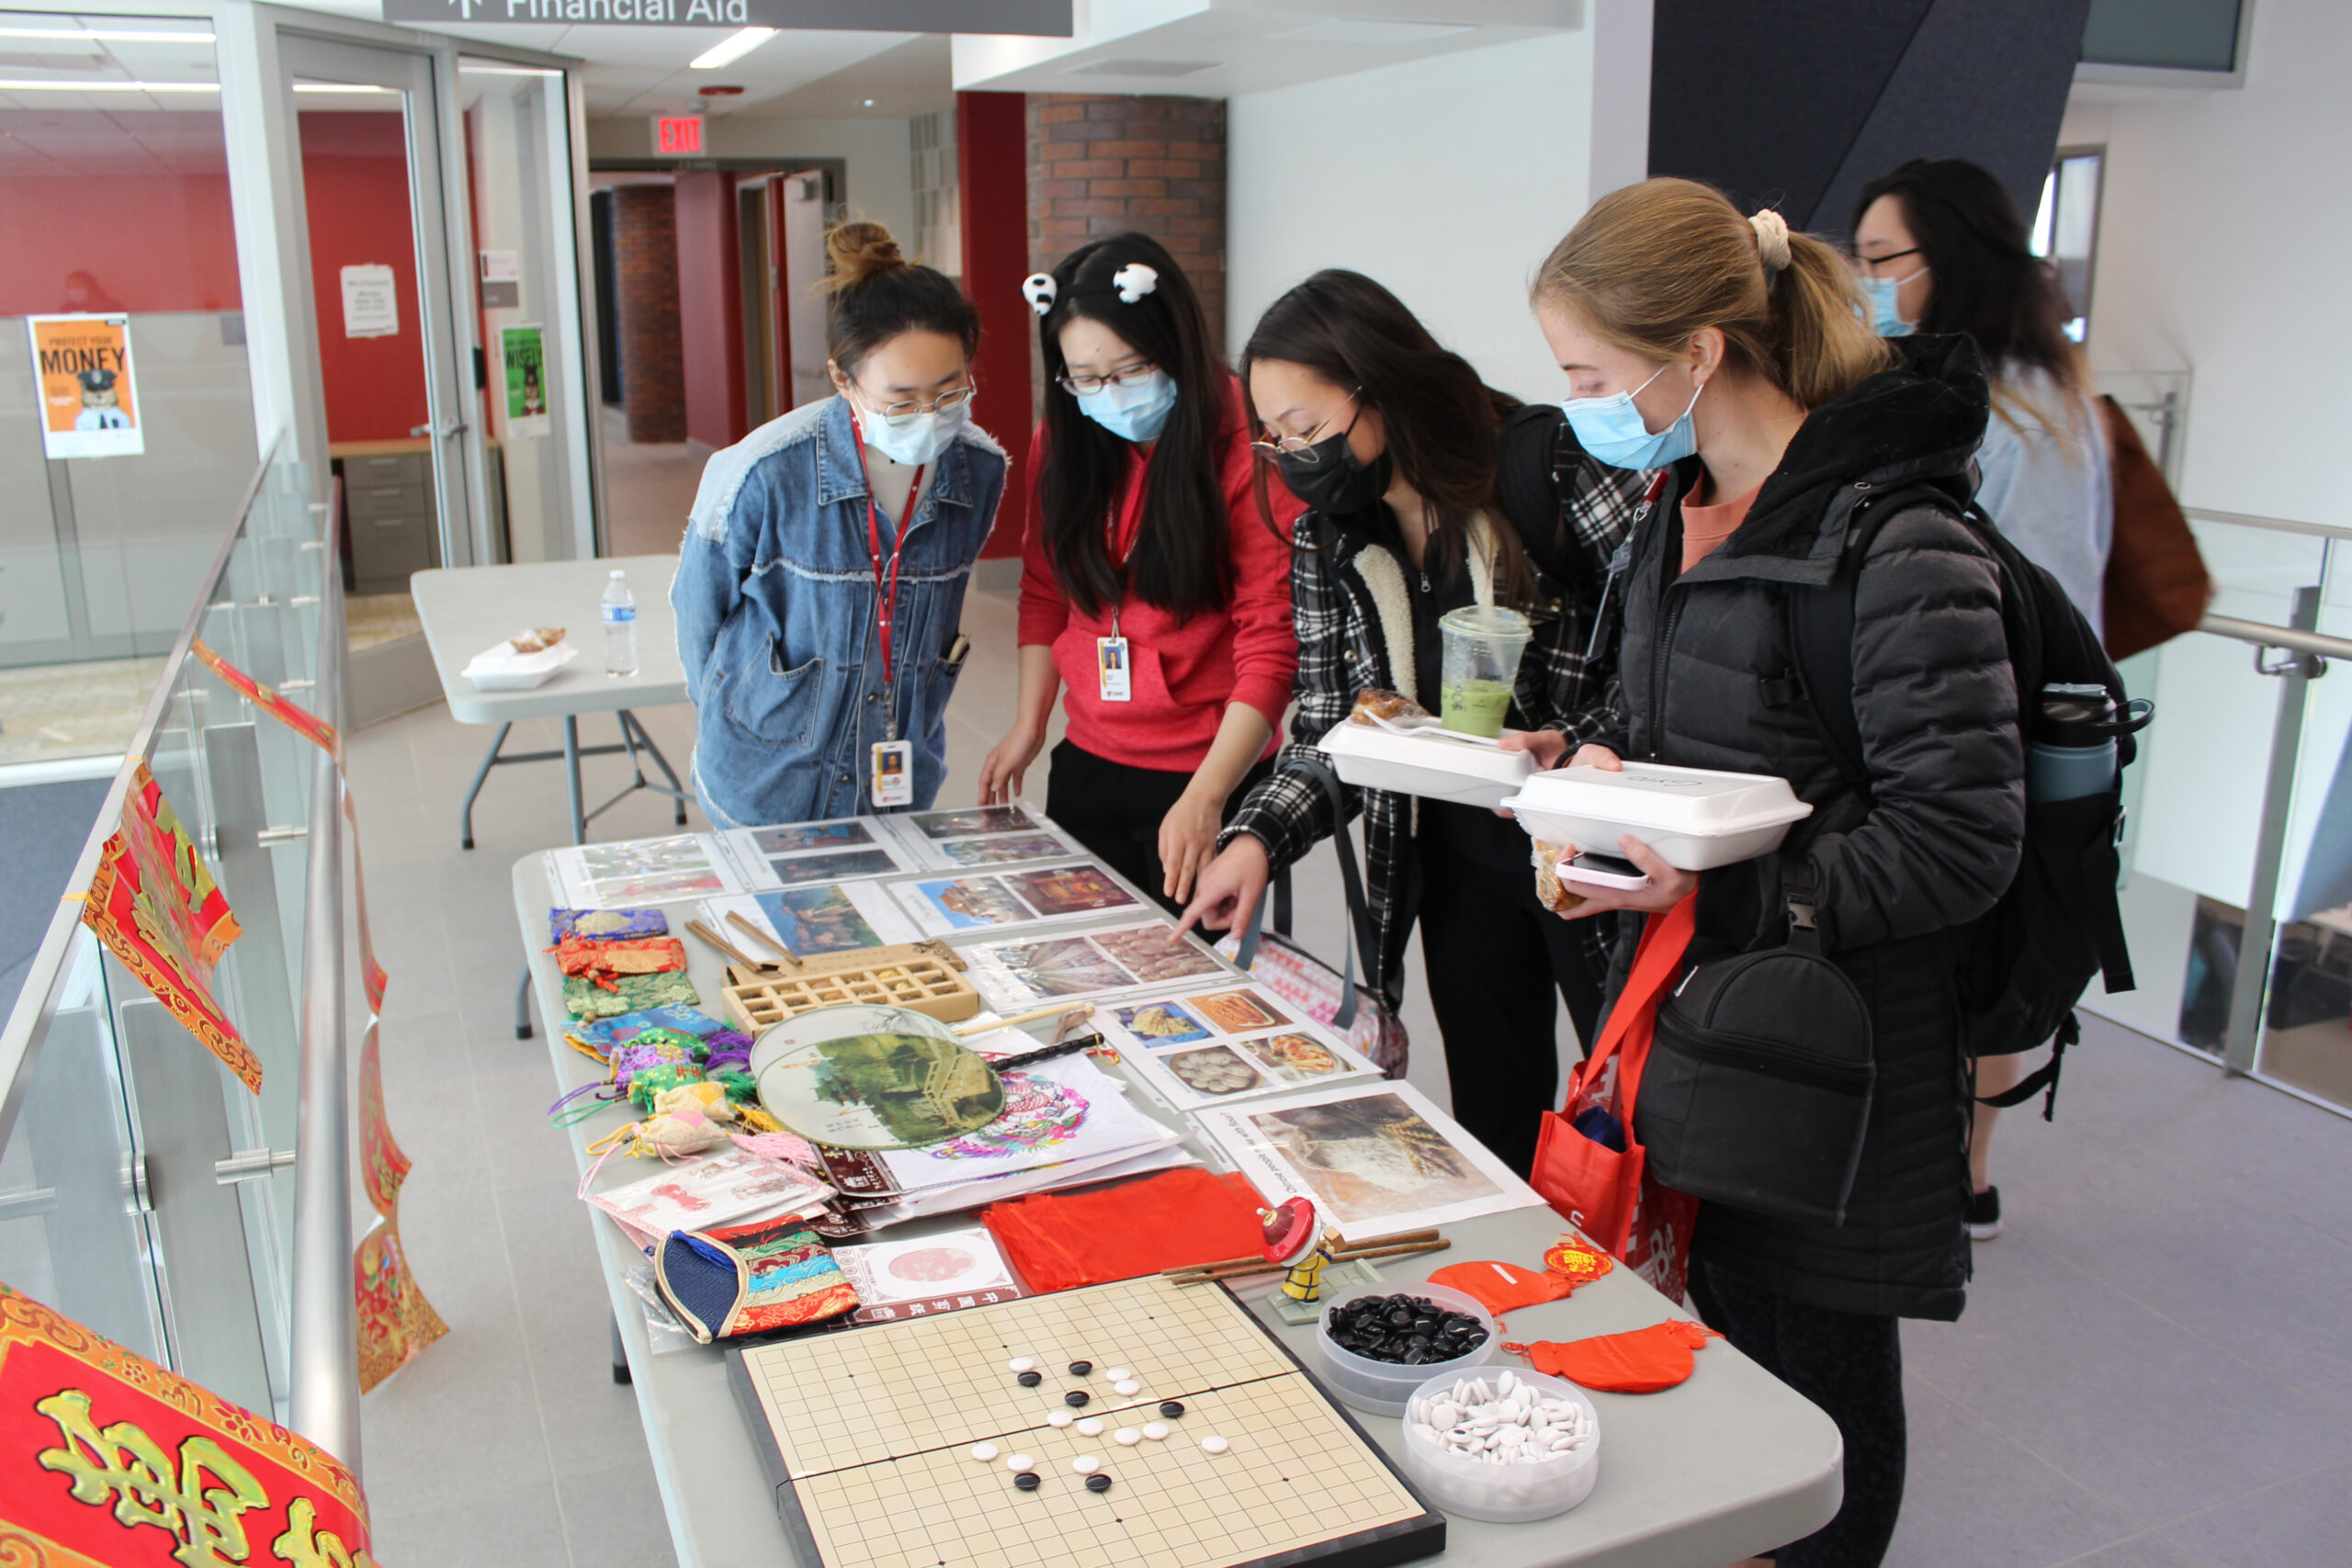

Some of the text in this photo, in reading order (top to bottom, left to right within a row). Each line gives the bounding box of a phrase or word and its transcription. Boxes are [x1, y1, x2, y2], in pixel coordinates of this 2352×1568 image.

[505, 0, 748, 23] Financial Aid
[659, 118, 701, 153] EXIT
[40, 346, 125, 374] MONEY
[1257, 1153, 1281, 1173] people
[1274, 1172, 1297, 1194] Chinese
